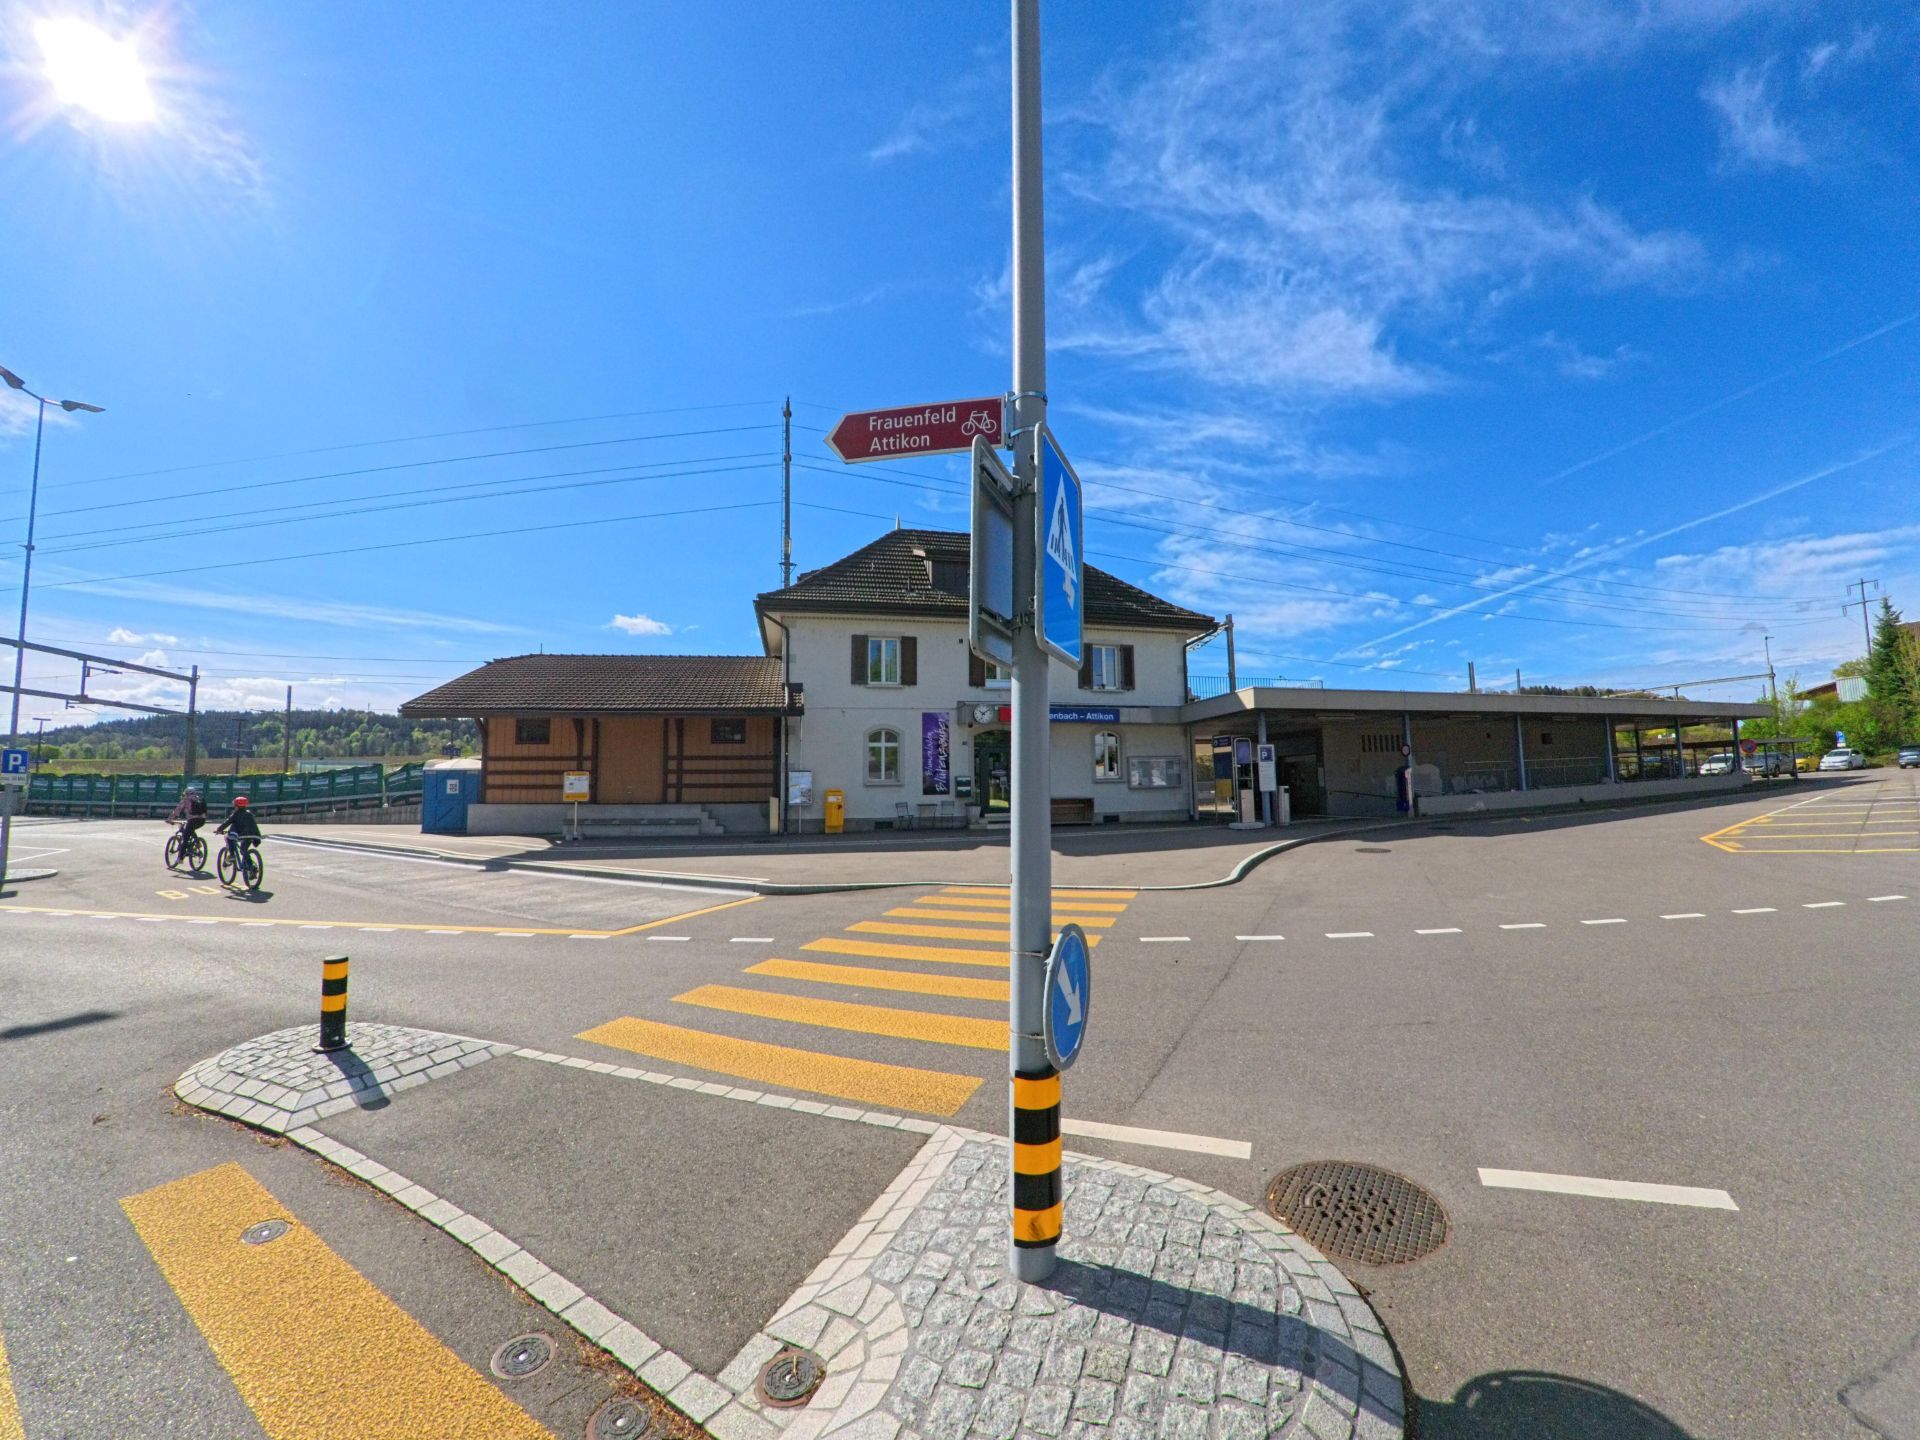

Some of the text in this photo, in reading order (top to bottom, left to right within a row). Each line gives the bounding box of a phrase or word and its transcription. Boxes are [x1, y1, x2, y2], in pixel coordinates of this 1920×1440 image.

[869, 406, 956, 431] Frauenfeld
[869, 433, 930, 453] Attikon
[1049, 711, 1078, 720] enbach
[1086, 712, 1115, 721] Attikon
[9, 753, 22, 771] P
[1261, 751, 1268, 760] P
